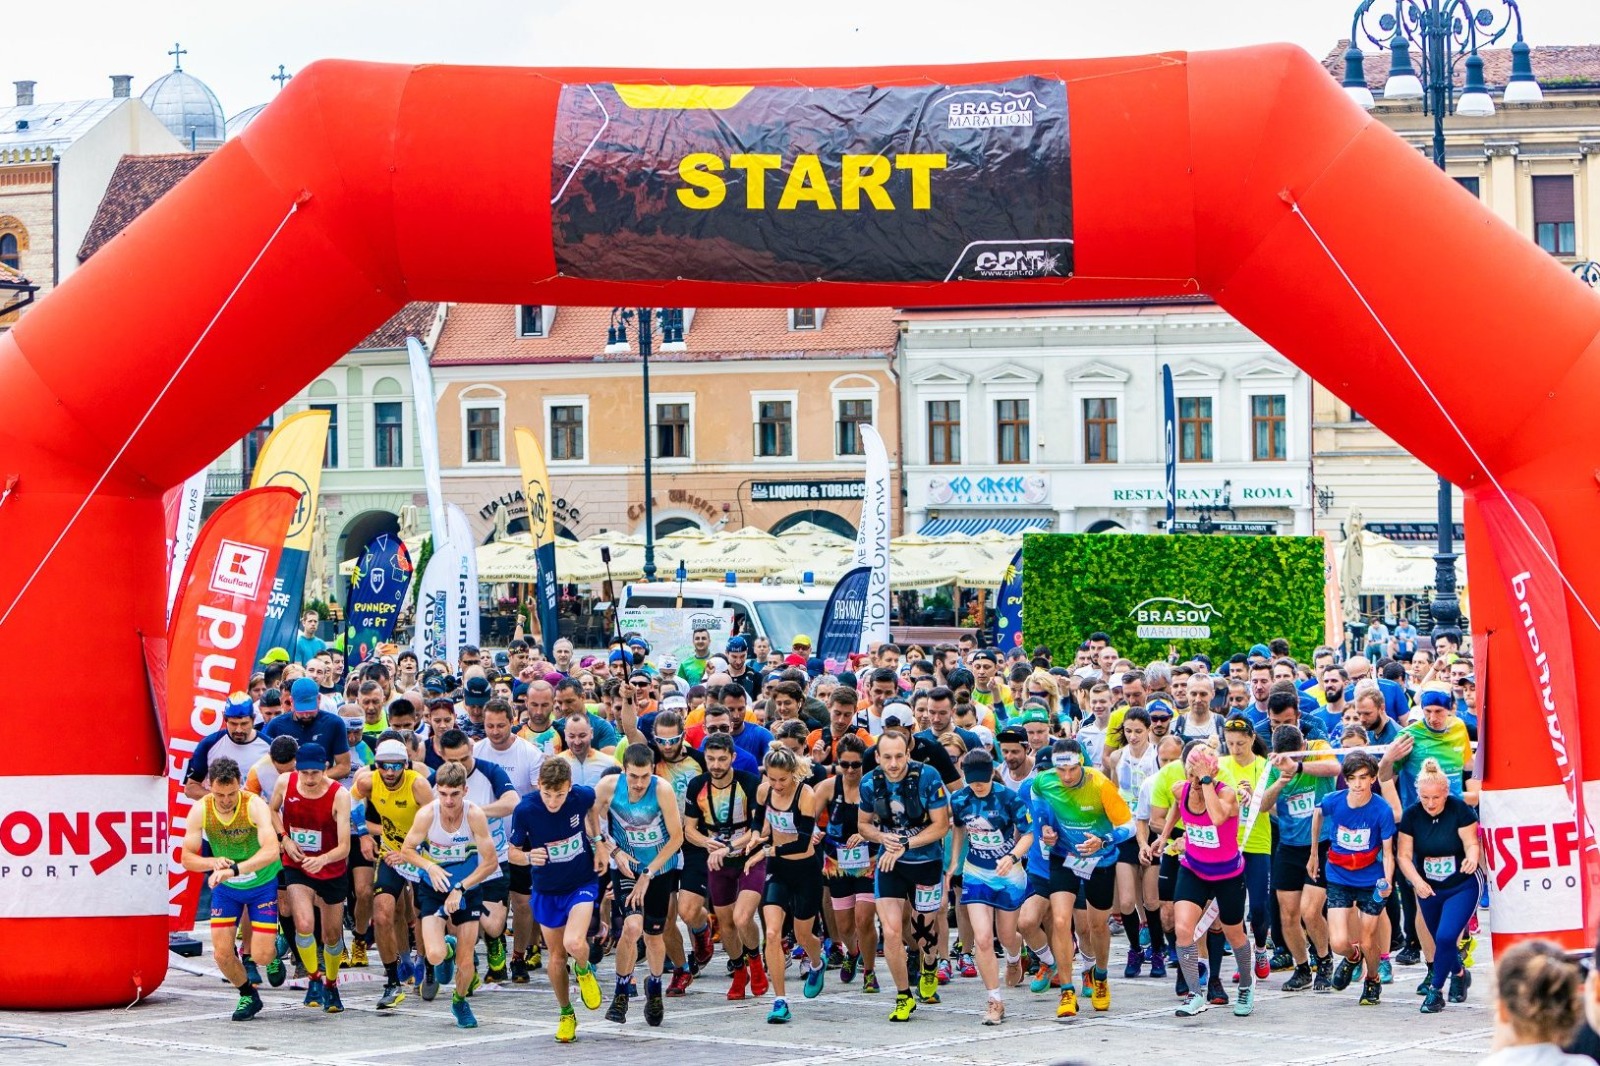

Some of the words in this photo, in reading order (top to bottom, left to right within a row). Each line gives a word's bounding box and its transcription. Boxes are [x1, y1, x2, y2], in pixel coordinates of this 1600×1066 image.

[950, 98, 1031, 114] BRASOV
[949, 112, 1032, 127] MARATHON
[676, 152, 948, 210] START
[975, 250, 1044, 271] CPNT
[980, 269, 1034, 277] www.cpnt.ro
[949, 476, 971, 493] GO
[977, 476, 1025, 493] GREEK
[769, 485, 809, 499] LIQUOR
[810, 486, 819, 497] &
[1114, 488, 1222, 500] RESTARANT
[1243, 488, 1293, 498] ROMA
[218, 574, 253, 589] Kaufland
[354, 602, 396, 614] RUNNERS
[362, 617, 373, 627] OF
[1137, 610, 1211, 622] BRASOV
[1139, 626, 1207, 638] MARATHON
[629, 829, 658, 842] 138
[1187, 827, 1214, 841] 228
[1342, 833, 1363, 844] 84
[550, 838, 581, 857] 370
[843, 849, 862, 861] 75
[2, 865, 79, 877] PORT
[1425, 861, 1453, 874] 322
[917, 888, 941, 903] 175
